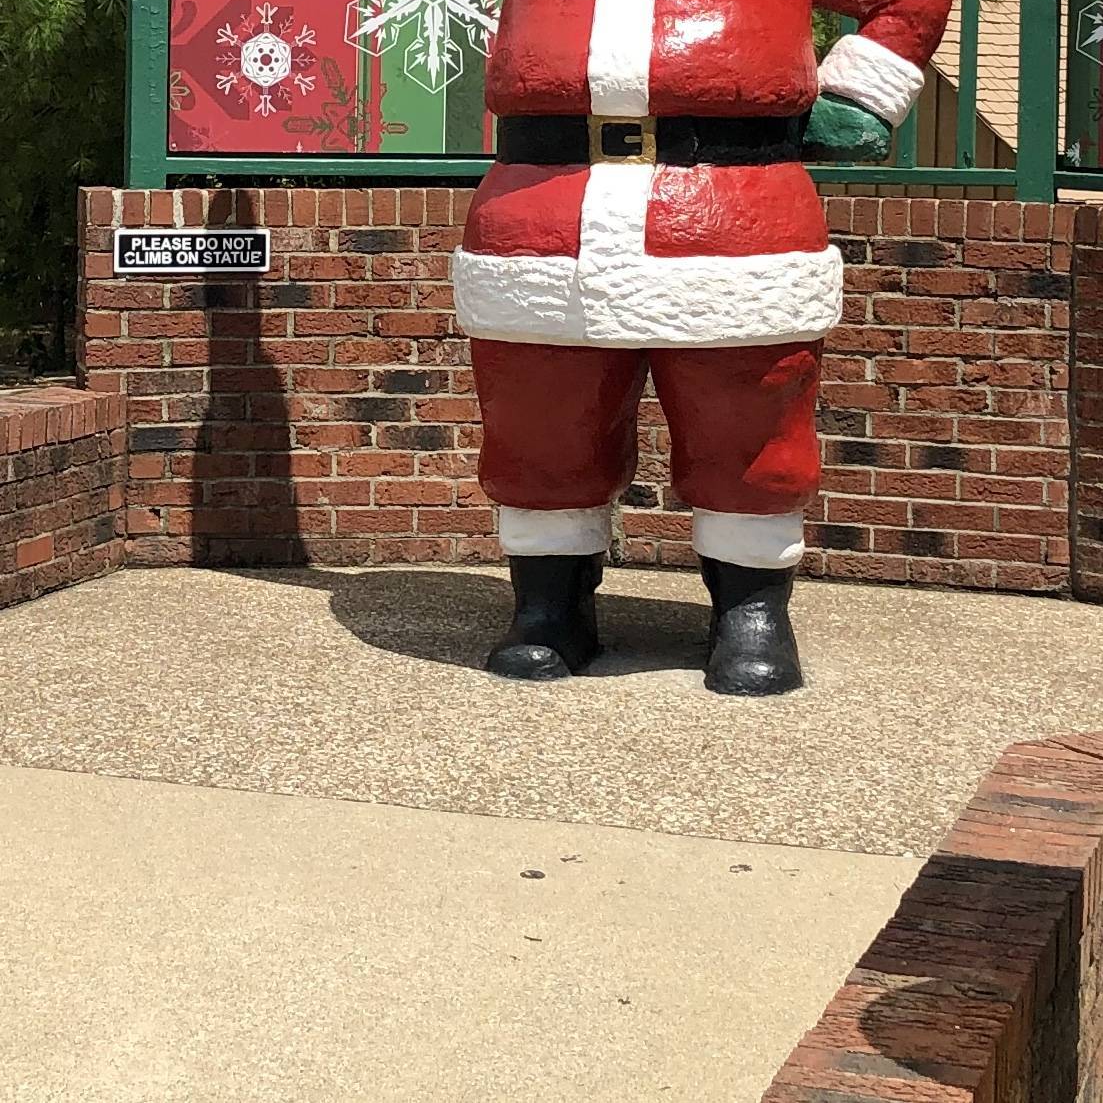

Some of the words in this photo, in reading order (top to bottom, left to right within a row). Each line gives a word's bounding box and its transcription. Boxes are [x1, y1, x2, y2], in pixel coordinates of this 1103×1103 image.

[131, 237, 192, 251] PLEASE
[195, 237, 218, 251] DO
[222, 237, 254, 250] NOT
[124, 251, 172, 265] CLIMB
[176, 251, 199, 265] ON
[202, 251, 262, 265] STATUE
